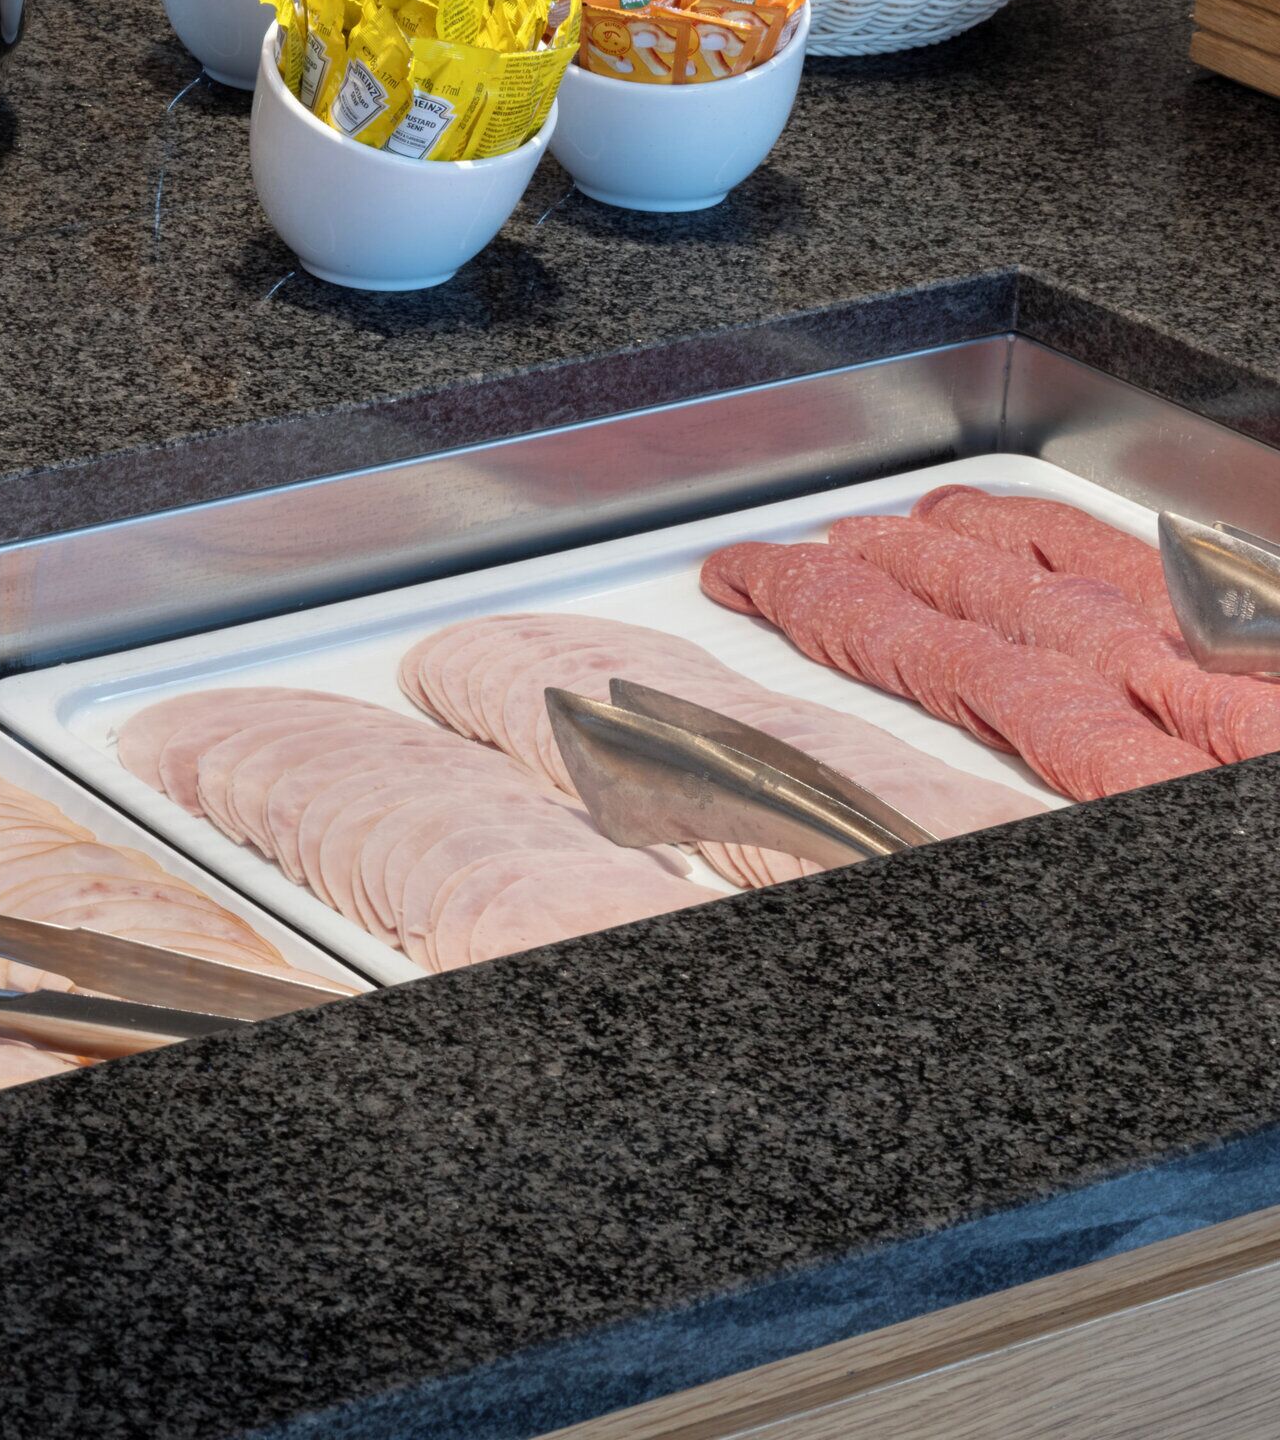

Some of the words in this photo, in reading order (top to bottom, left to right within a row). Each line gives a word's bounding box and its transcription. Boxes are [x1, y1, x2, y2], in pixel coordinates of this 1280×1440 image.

[355, 69, 378, 97] HEINZ
[441, 85, 461, 97] 17ml
[407, 122, 424, 133] SENF
